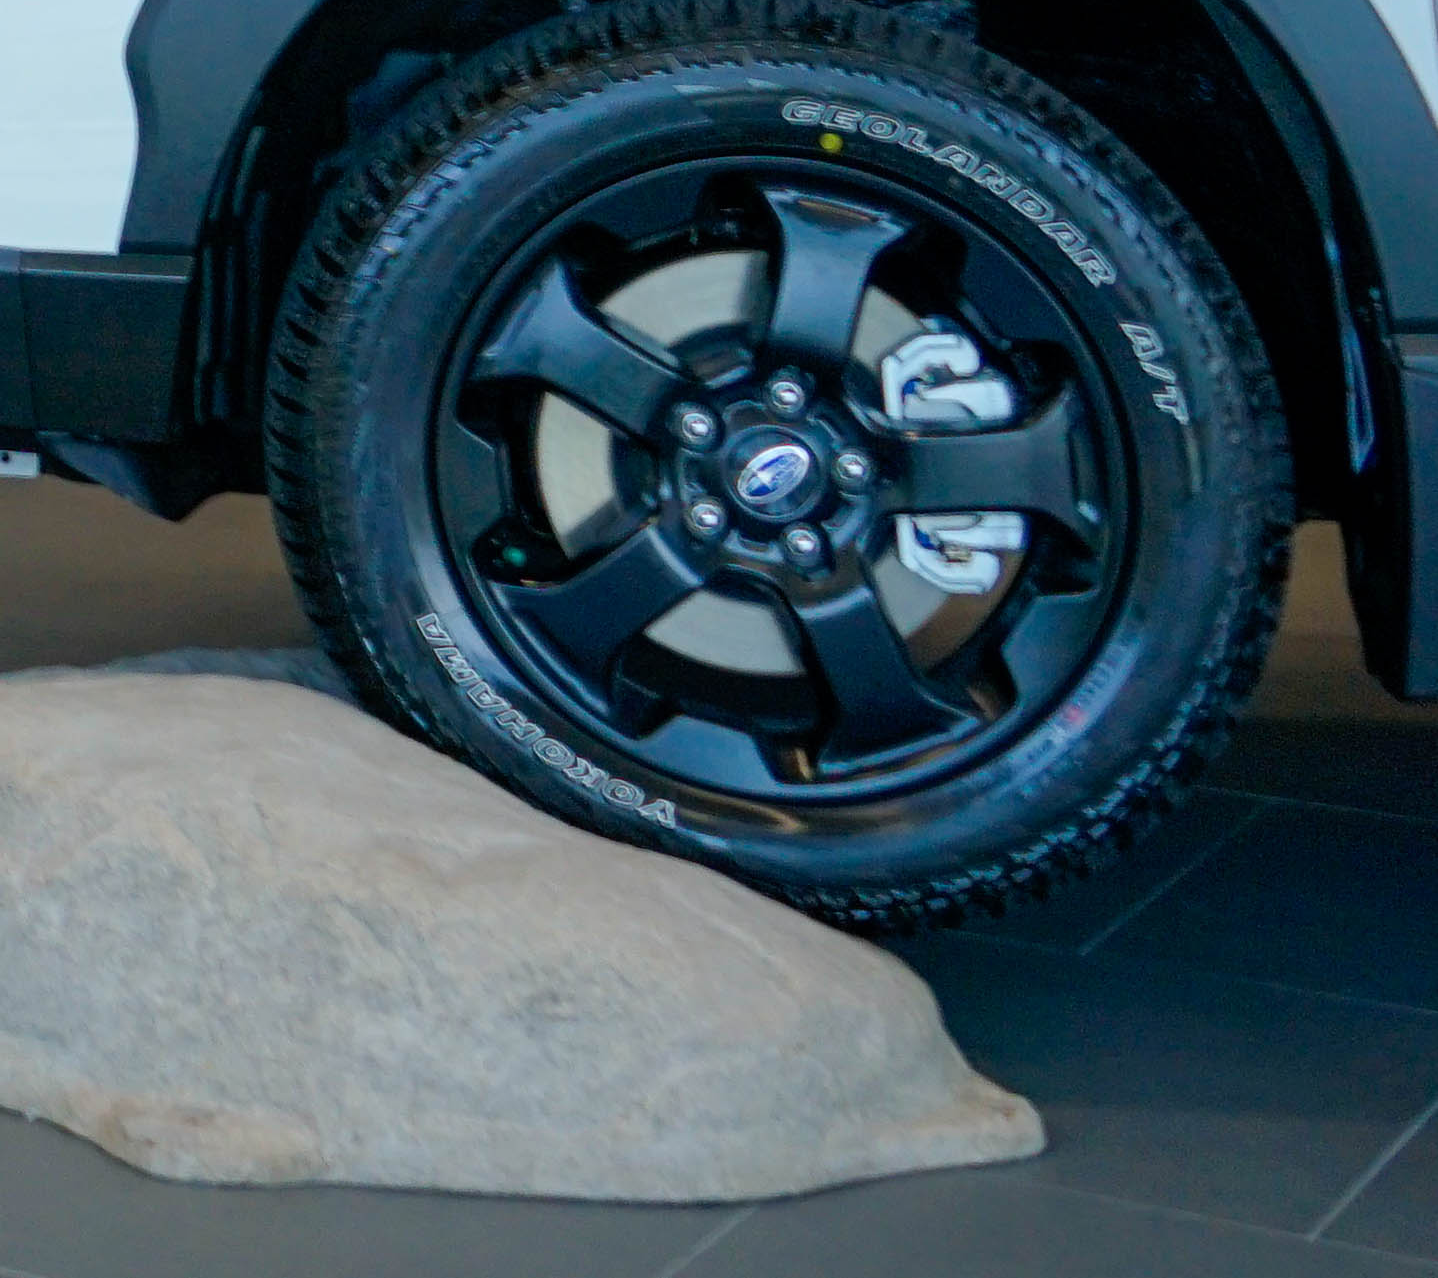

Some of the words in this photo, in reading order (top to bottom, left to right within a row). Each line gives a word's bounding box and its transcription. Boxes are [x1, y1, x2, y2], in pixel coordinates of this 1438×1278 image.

[781, 99, 1117, 288] GEOLANDAR
[1119, 320, 1189, 425] A/T
[416, 612, 676, 829] YOKOHAMA
